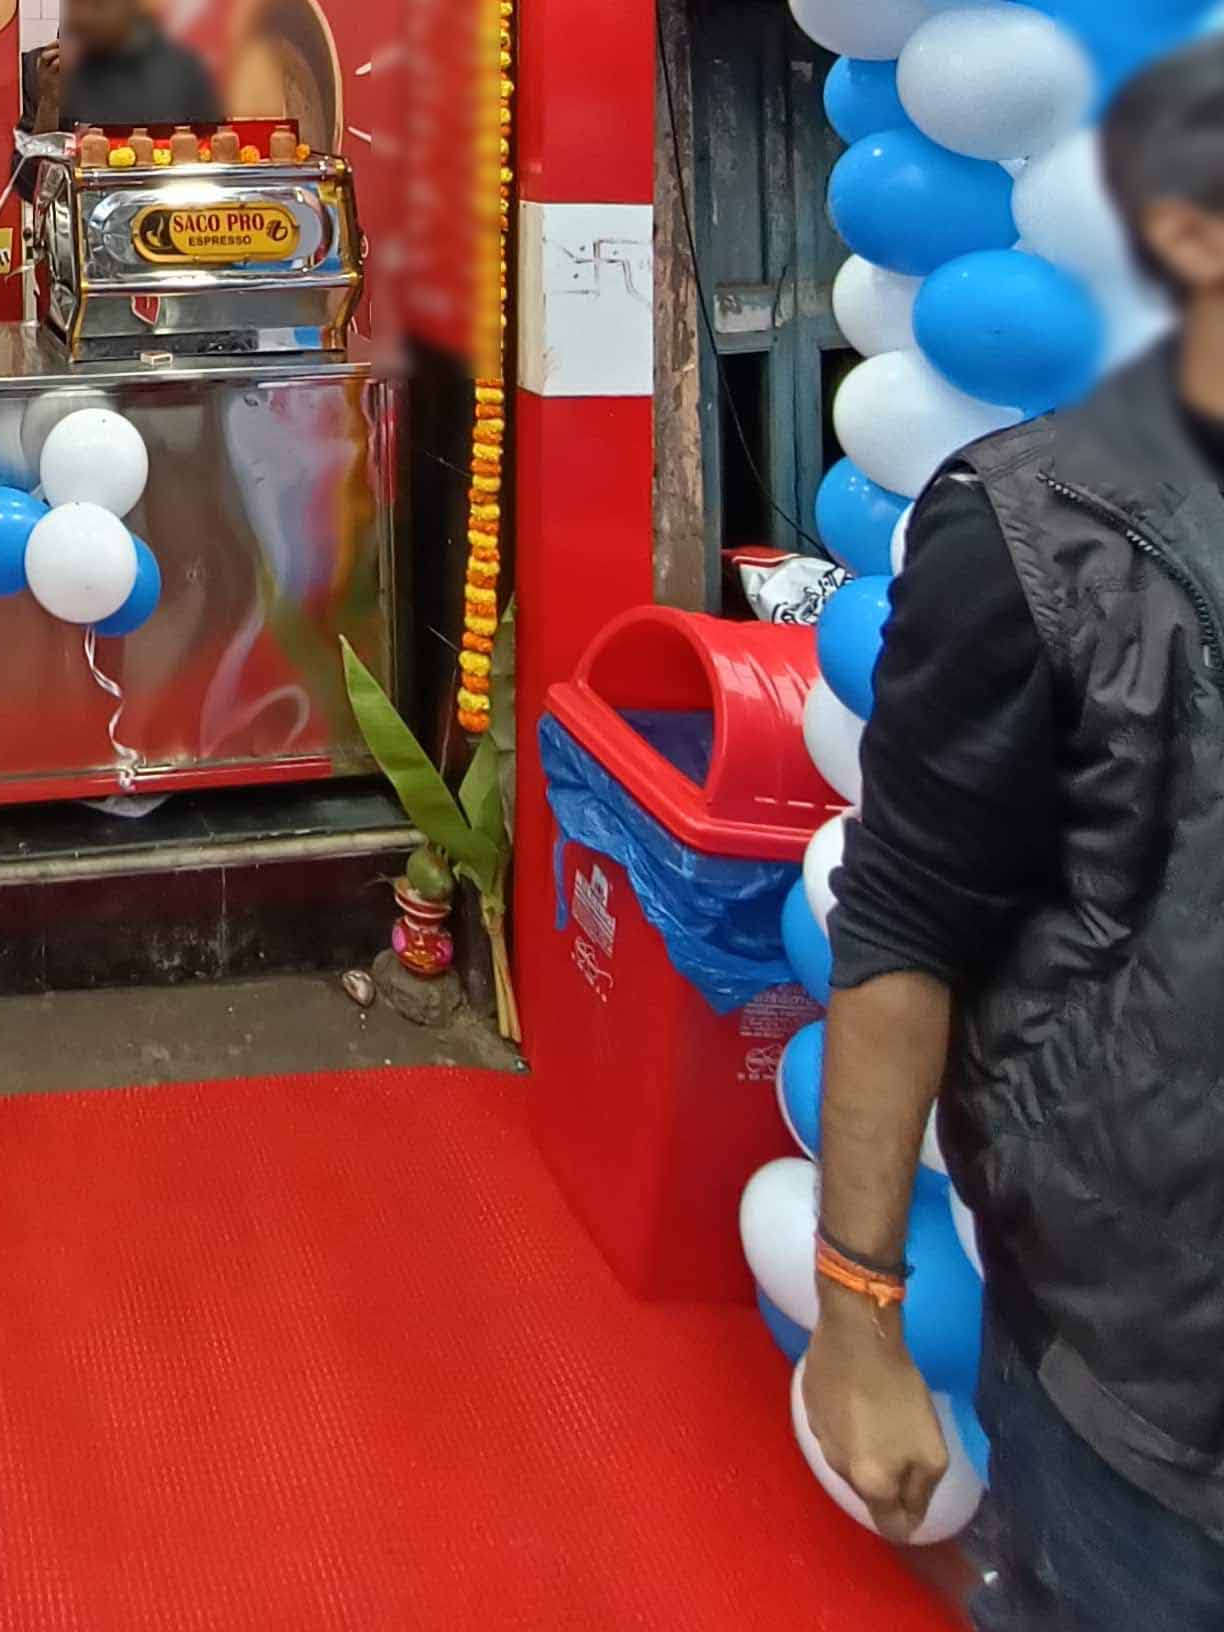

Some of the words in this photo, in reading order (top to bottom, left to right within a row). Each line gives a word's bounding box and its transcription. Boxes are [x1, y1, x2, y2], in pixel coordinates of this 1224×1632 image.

[172, 213, 221, 233] SACO
[227, 212, 265, 232] PRO
[188, 234, 252, 247] ESPRESSO
